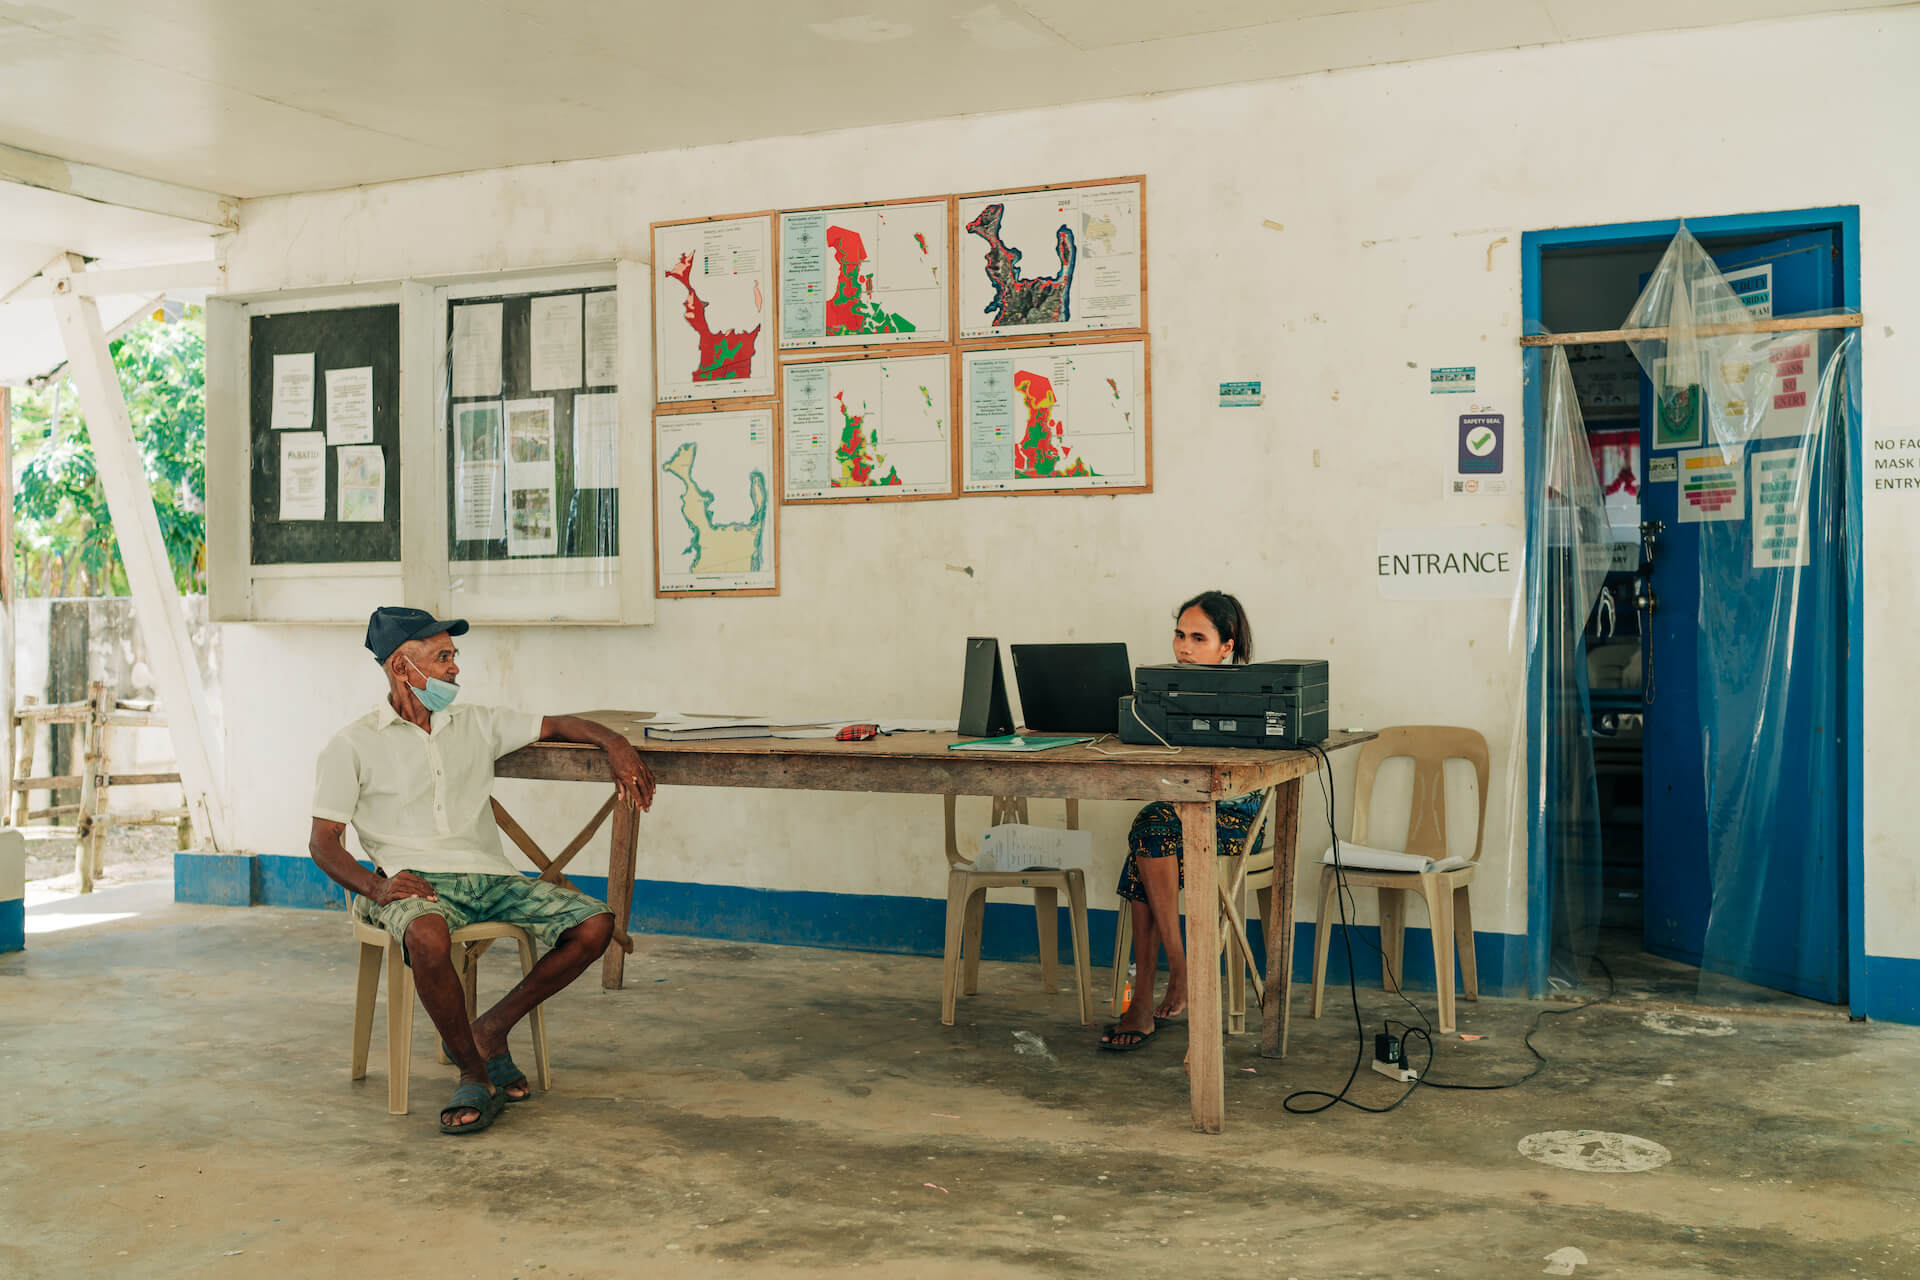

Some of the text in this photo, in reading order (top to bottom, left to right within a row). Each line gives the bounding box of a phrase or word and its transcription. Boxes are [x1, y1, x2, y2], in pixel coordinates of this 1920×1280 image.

[1774, 394, 1805, 408] ENTRY
[1874, 439, 1895, 450] NO
[1874, 458, 1914, 469] MASK
[1875, 477, 1920, 490] ENTRY
[1378, 551, 1510, 576] ENTRANCE
